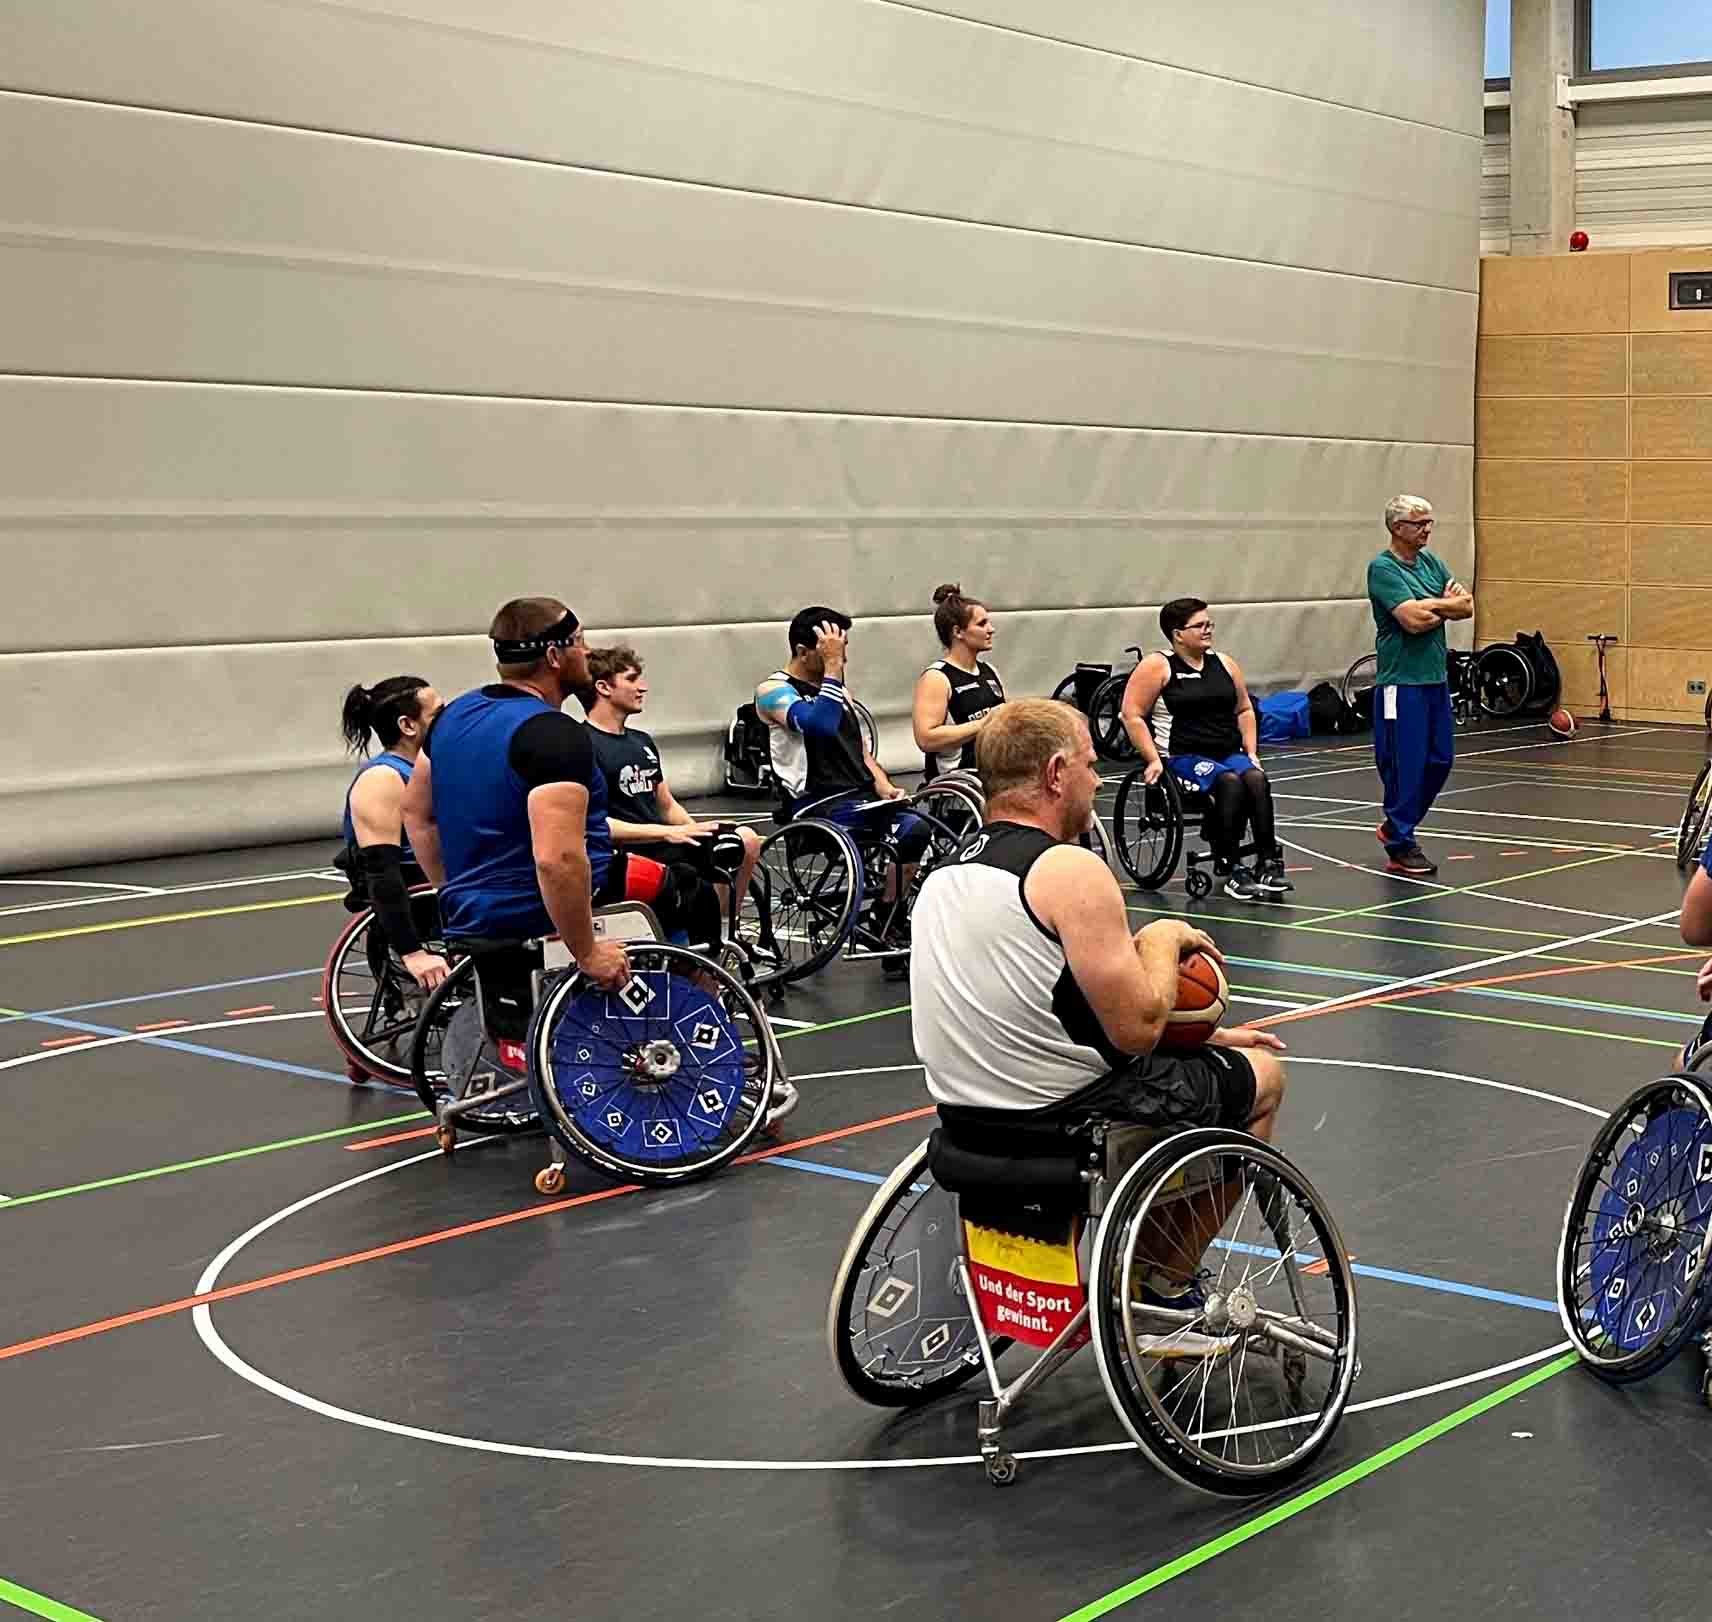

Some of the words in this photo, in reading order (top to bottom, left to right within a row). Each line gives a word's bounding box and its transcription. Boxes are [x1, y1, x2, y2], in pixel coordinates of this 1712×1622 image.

[978, 1273, 1003, 1297] Und
[1005, 1282, 1024, 1304] der
[1026, 1290, 1073, 1312] Sport
[997, 1304, 1054, 1333] gewinnt.
